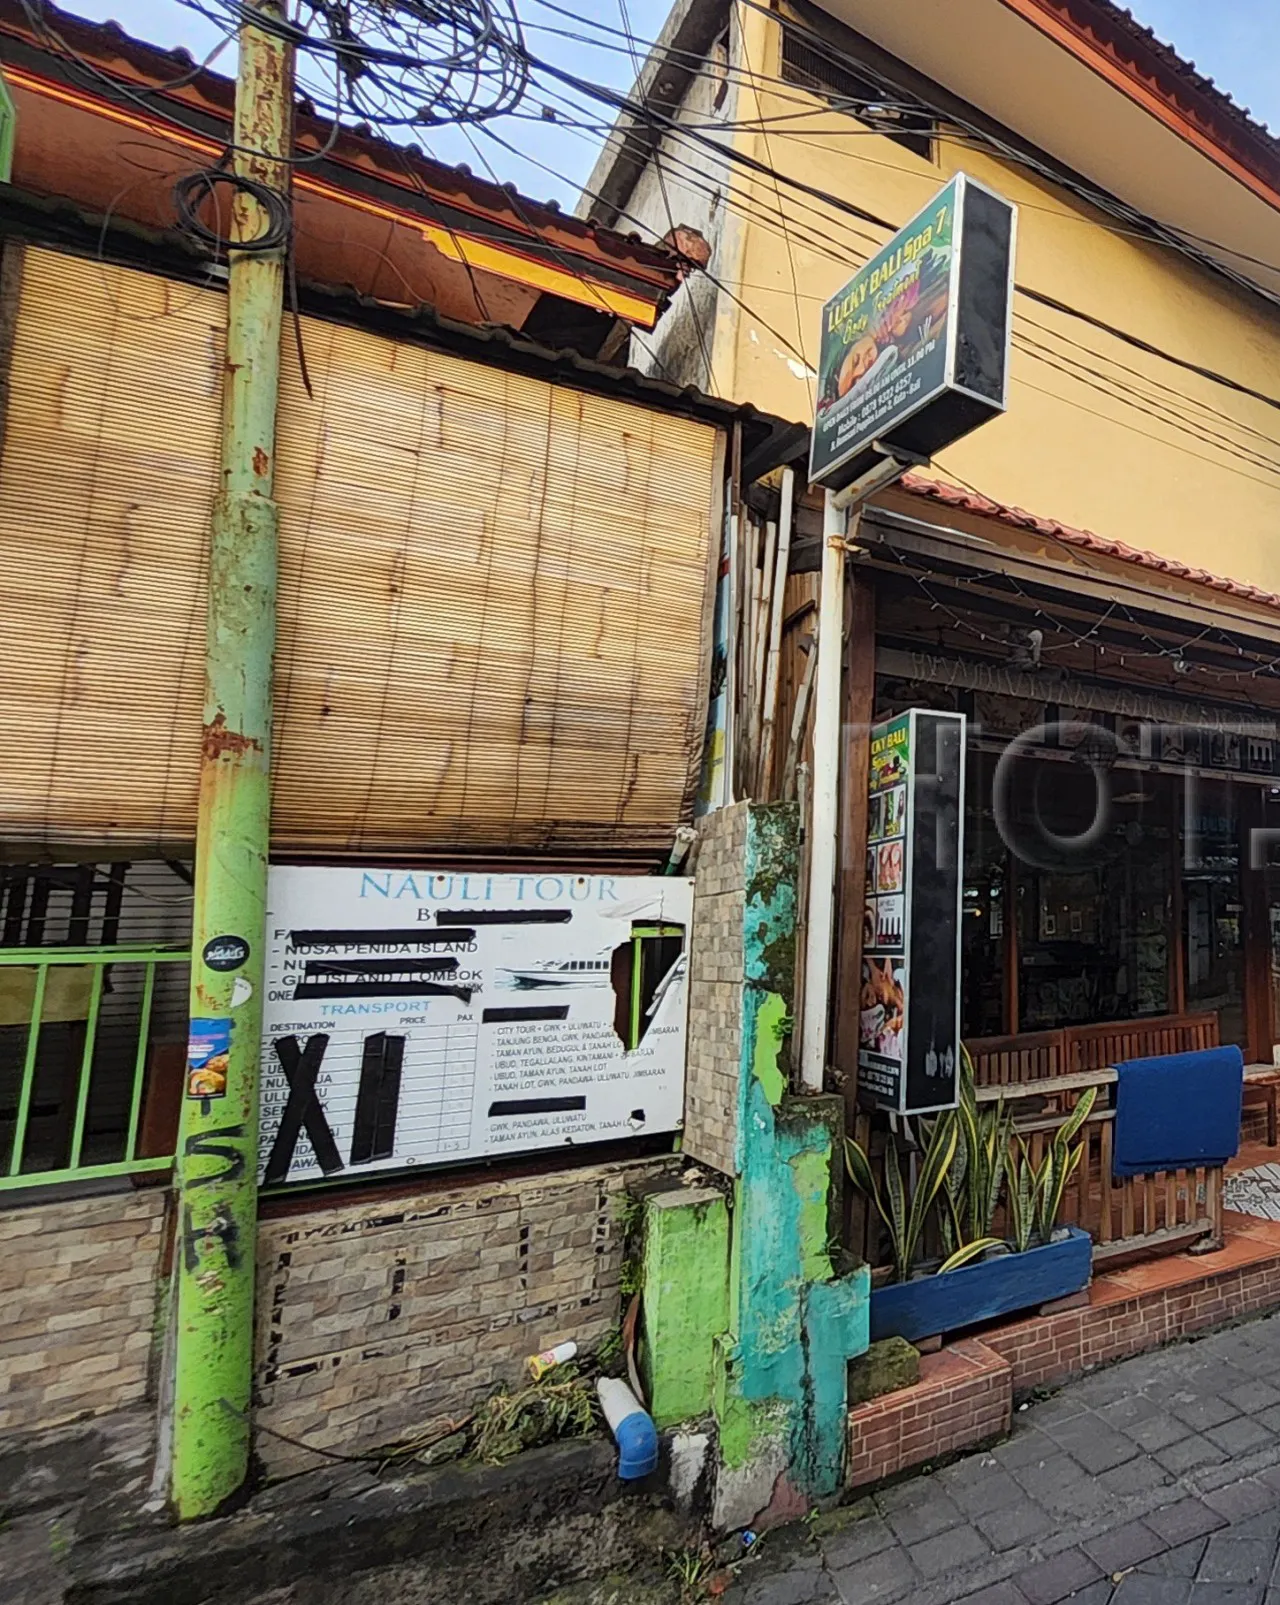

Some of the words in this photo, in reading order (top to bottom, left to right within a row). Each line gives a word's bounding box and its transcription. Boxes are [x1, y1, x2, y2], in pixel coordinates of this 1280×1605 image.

[828, 278, 869, 332] LUCKY
[870, 248, 902, 295] BALI
[903, 226, 932, 263] Spa
[935, 206, 947, 234] 7
[358, 872, 493, 901] NAULI
[509, 876, 620, 901] TOUR
[285, 943, 338, 955] NUSA
[343, 943, 414, 955] PENIDA
[416, 942, 478, 954] ISLAND
[319, 1000, 432, 1016] TRANSPORT
[269, 1020, 336, 1032] DESTINATION
[400, 1015, 426, 1024] PRICE
[456, 1014, 473, 1022] PAX
[497, 1027, 514, 1035] CITY
[516, 1025, 536, 1034] TOUR
[593, 1063, 608, 1071] LOT
